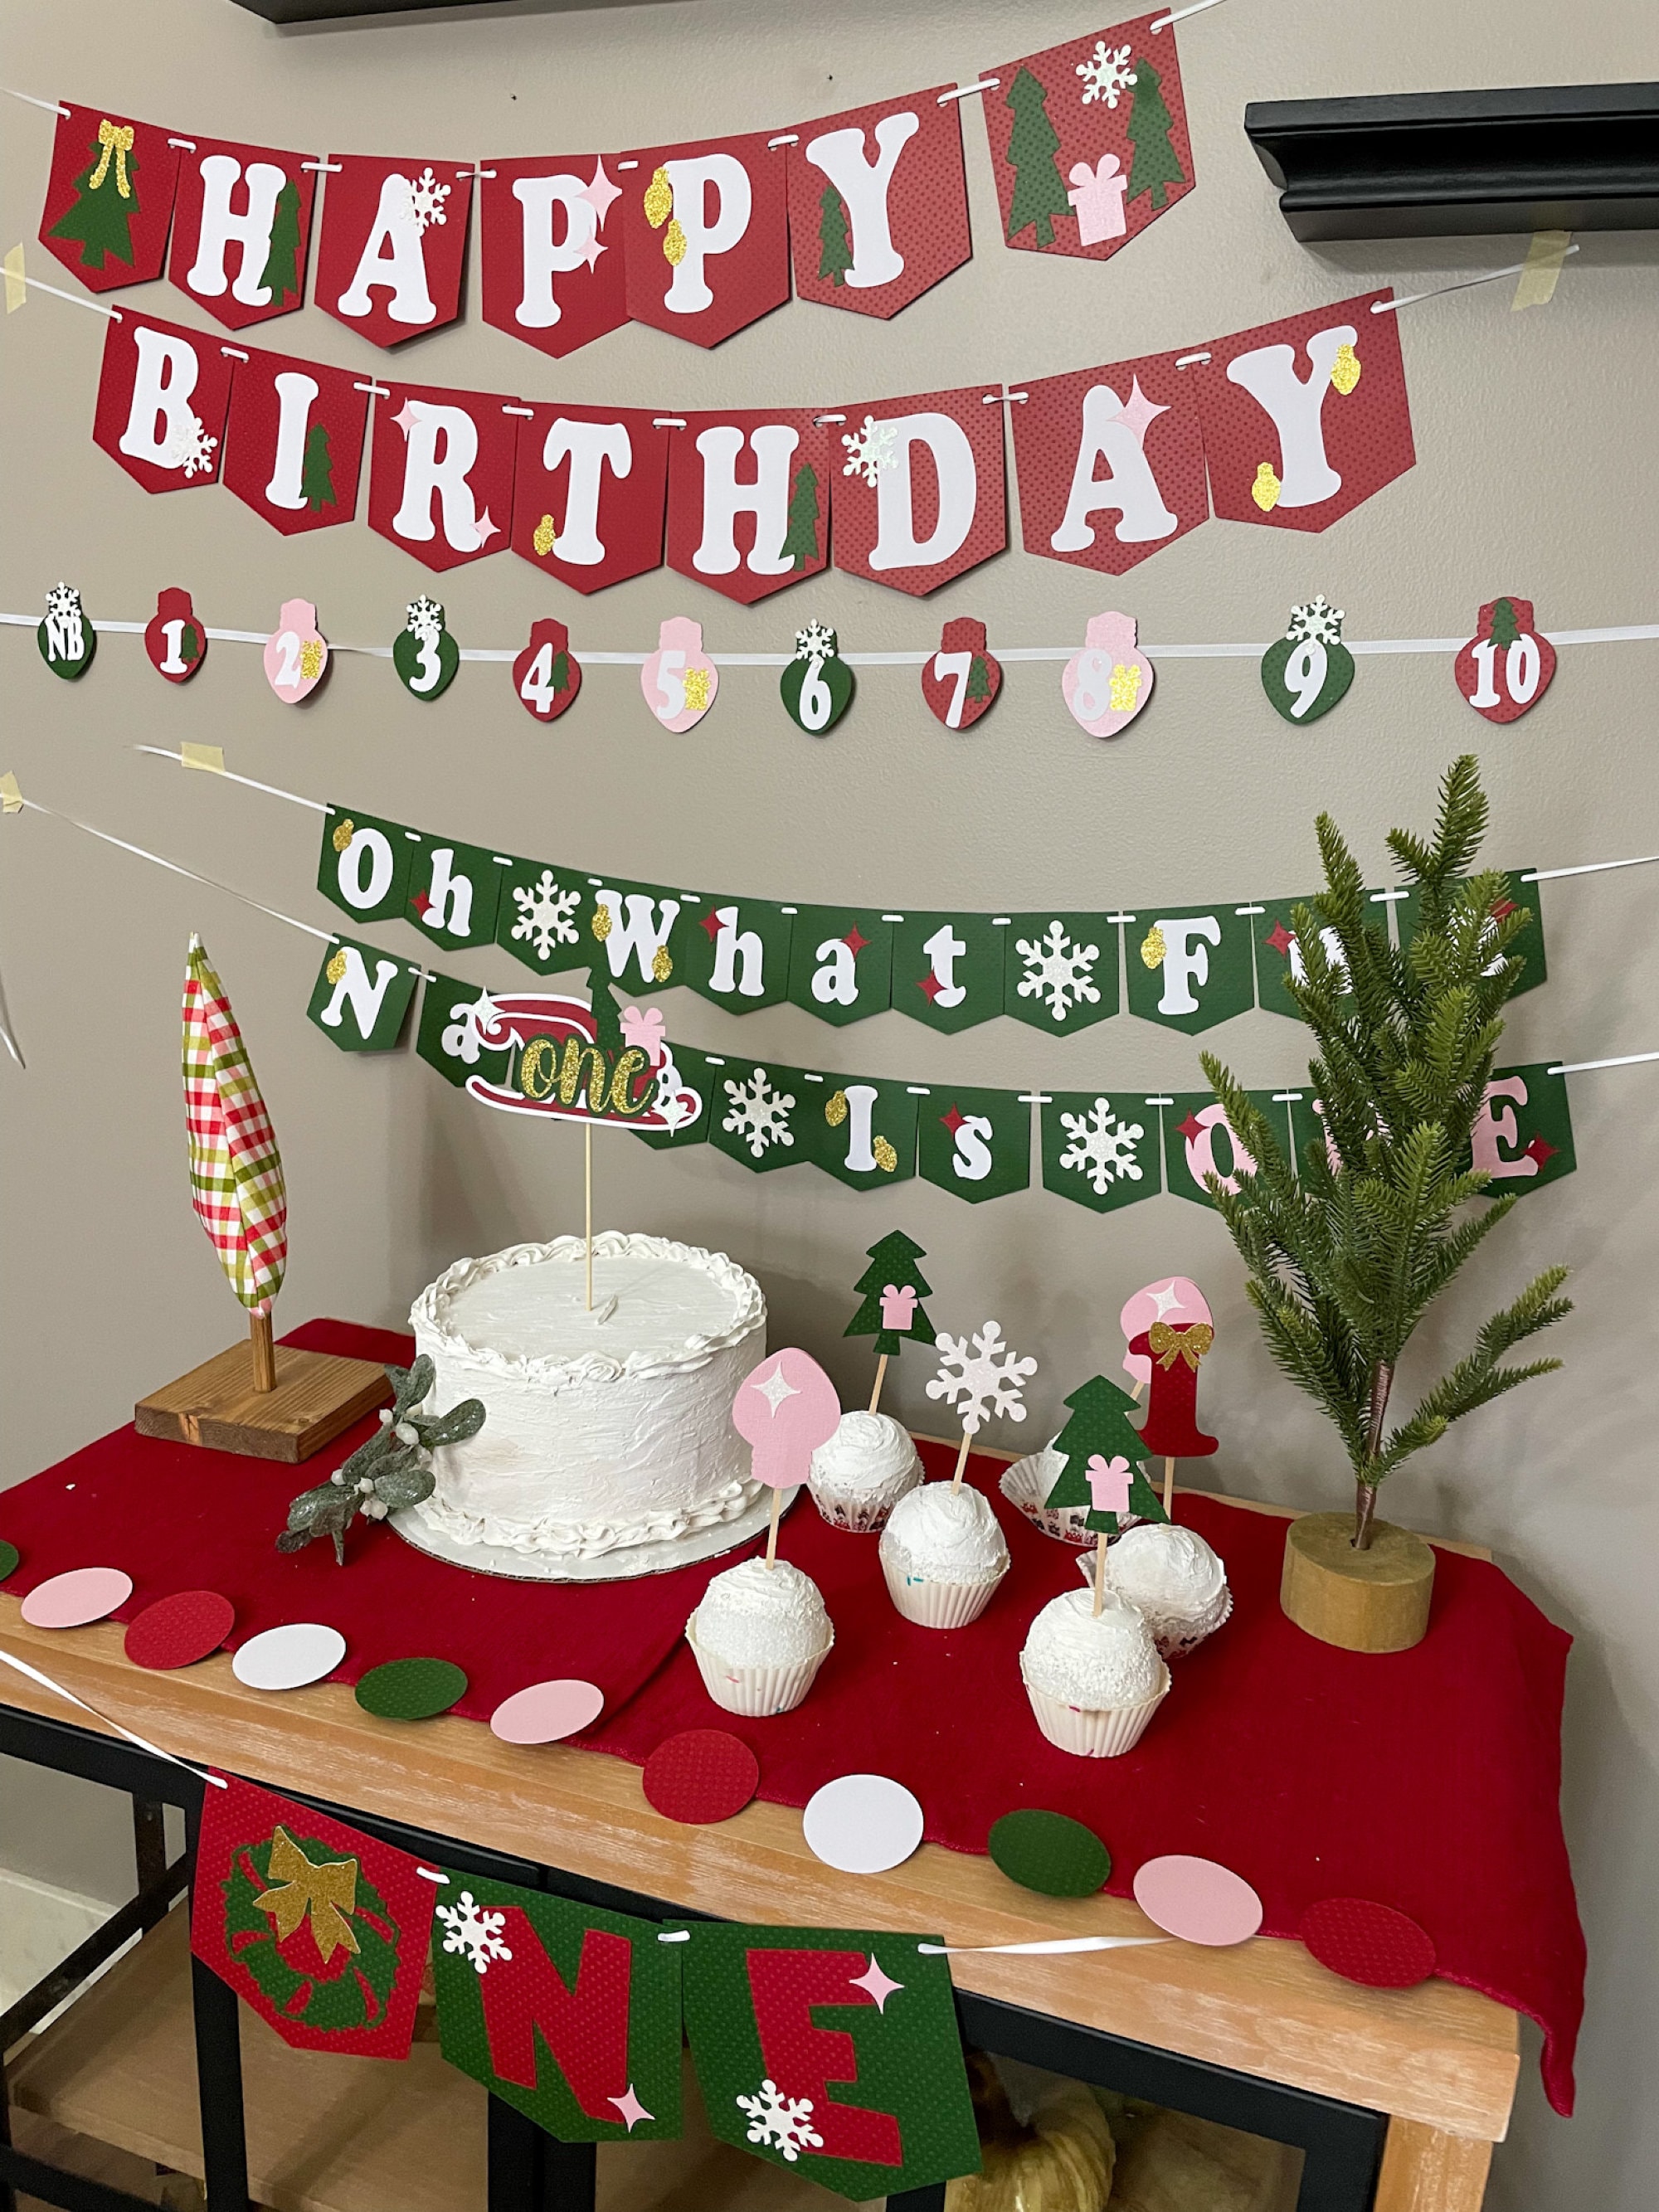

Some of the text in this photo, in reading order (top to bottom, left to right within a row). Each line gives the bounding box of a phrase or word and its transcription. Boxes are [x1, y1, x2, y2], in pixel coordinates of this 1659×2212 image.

[187, 113, 920, 328] HAPPY
[119, 325, 1358, 576] BIRTHDAY
[46, 614, 1540, 730] NB 1 2 3 4 5 6 7 8 9 10
[338, 828, 472, 936] Oh
[594, 890, 966, 1008] What
[520, 1038, 654, 1114] one
[844, 1085, 994, 1180] Is
[1185, 1076, 1539, 1195] OE
